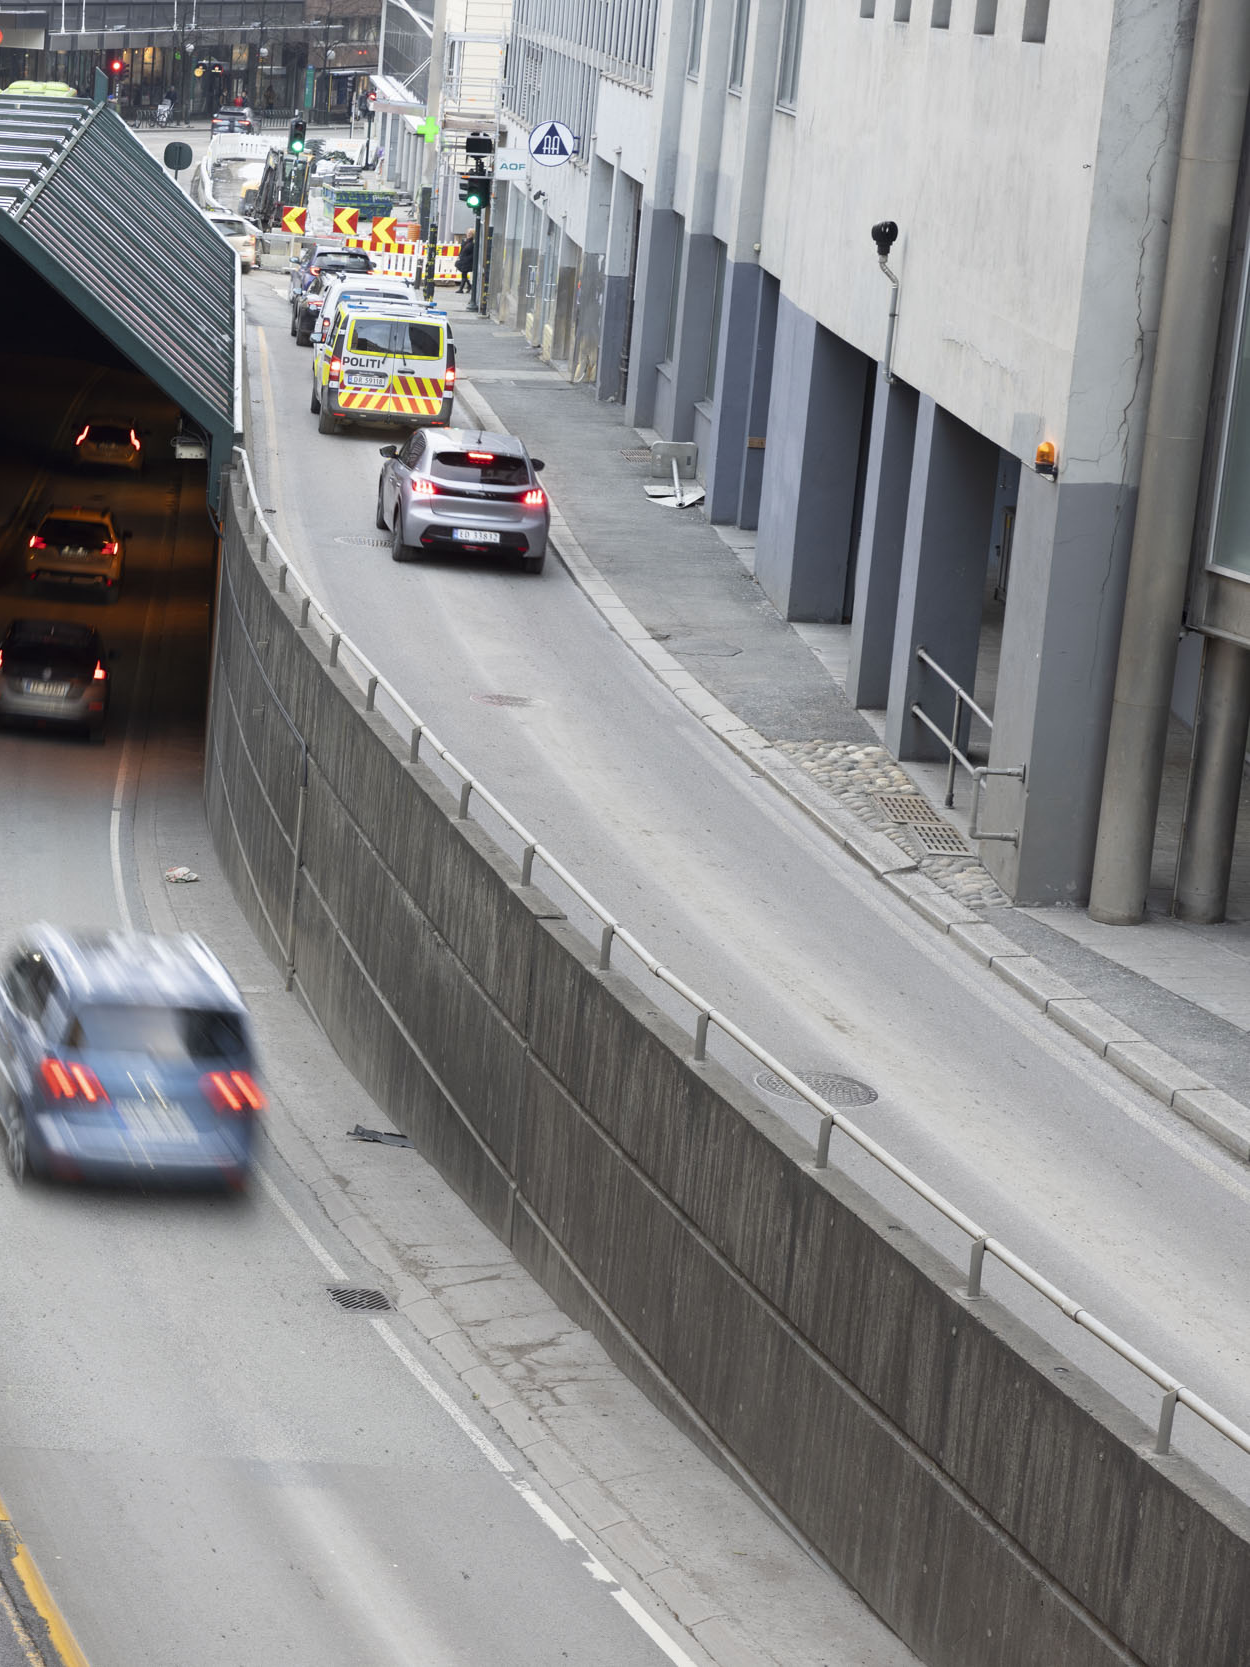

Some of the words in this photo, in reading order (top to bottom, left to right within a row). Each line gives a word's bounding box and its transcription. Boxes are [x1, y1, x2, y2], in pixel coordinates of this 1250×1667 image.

[542, 135, 560, 154] AA
[499, 163, 526, 171] AOF
[342, 356, 381, 369] POLITI
[353, 376, 363, 384] DR
[364, 376, 383, 386] 59118
